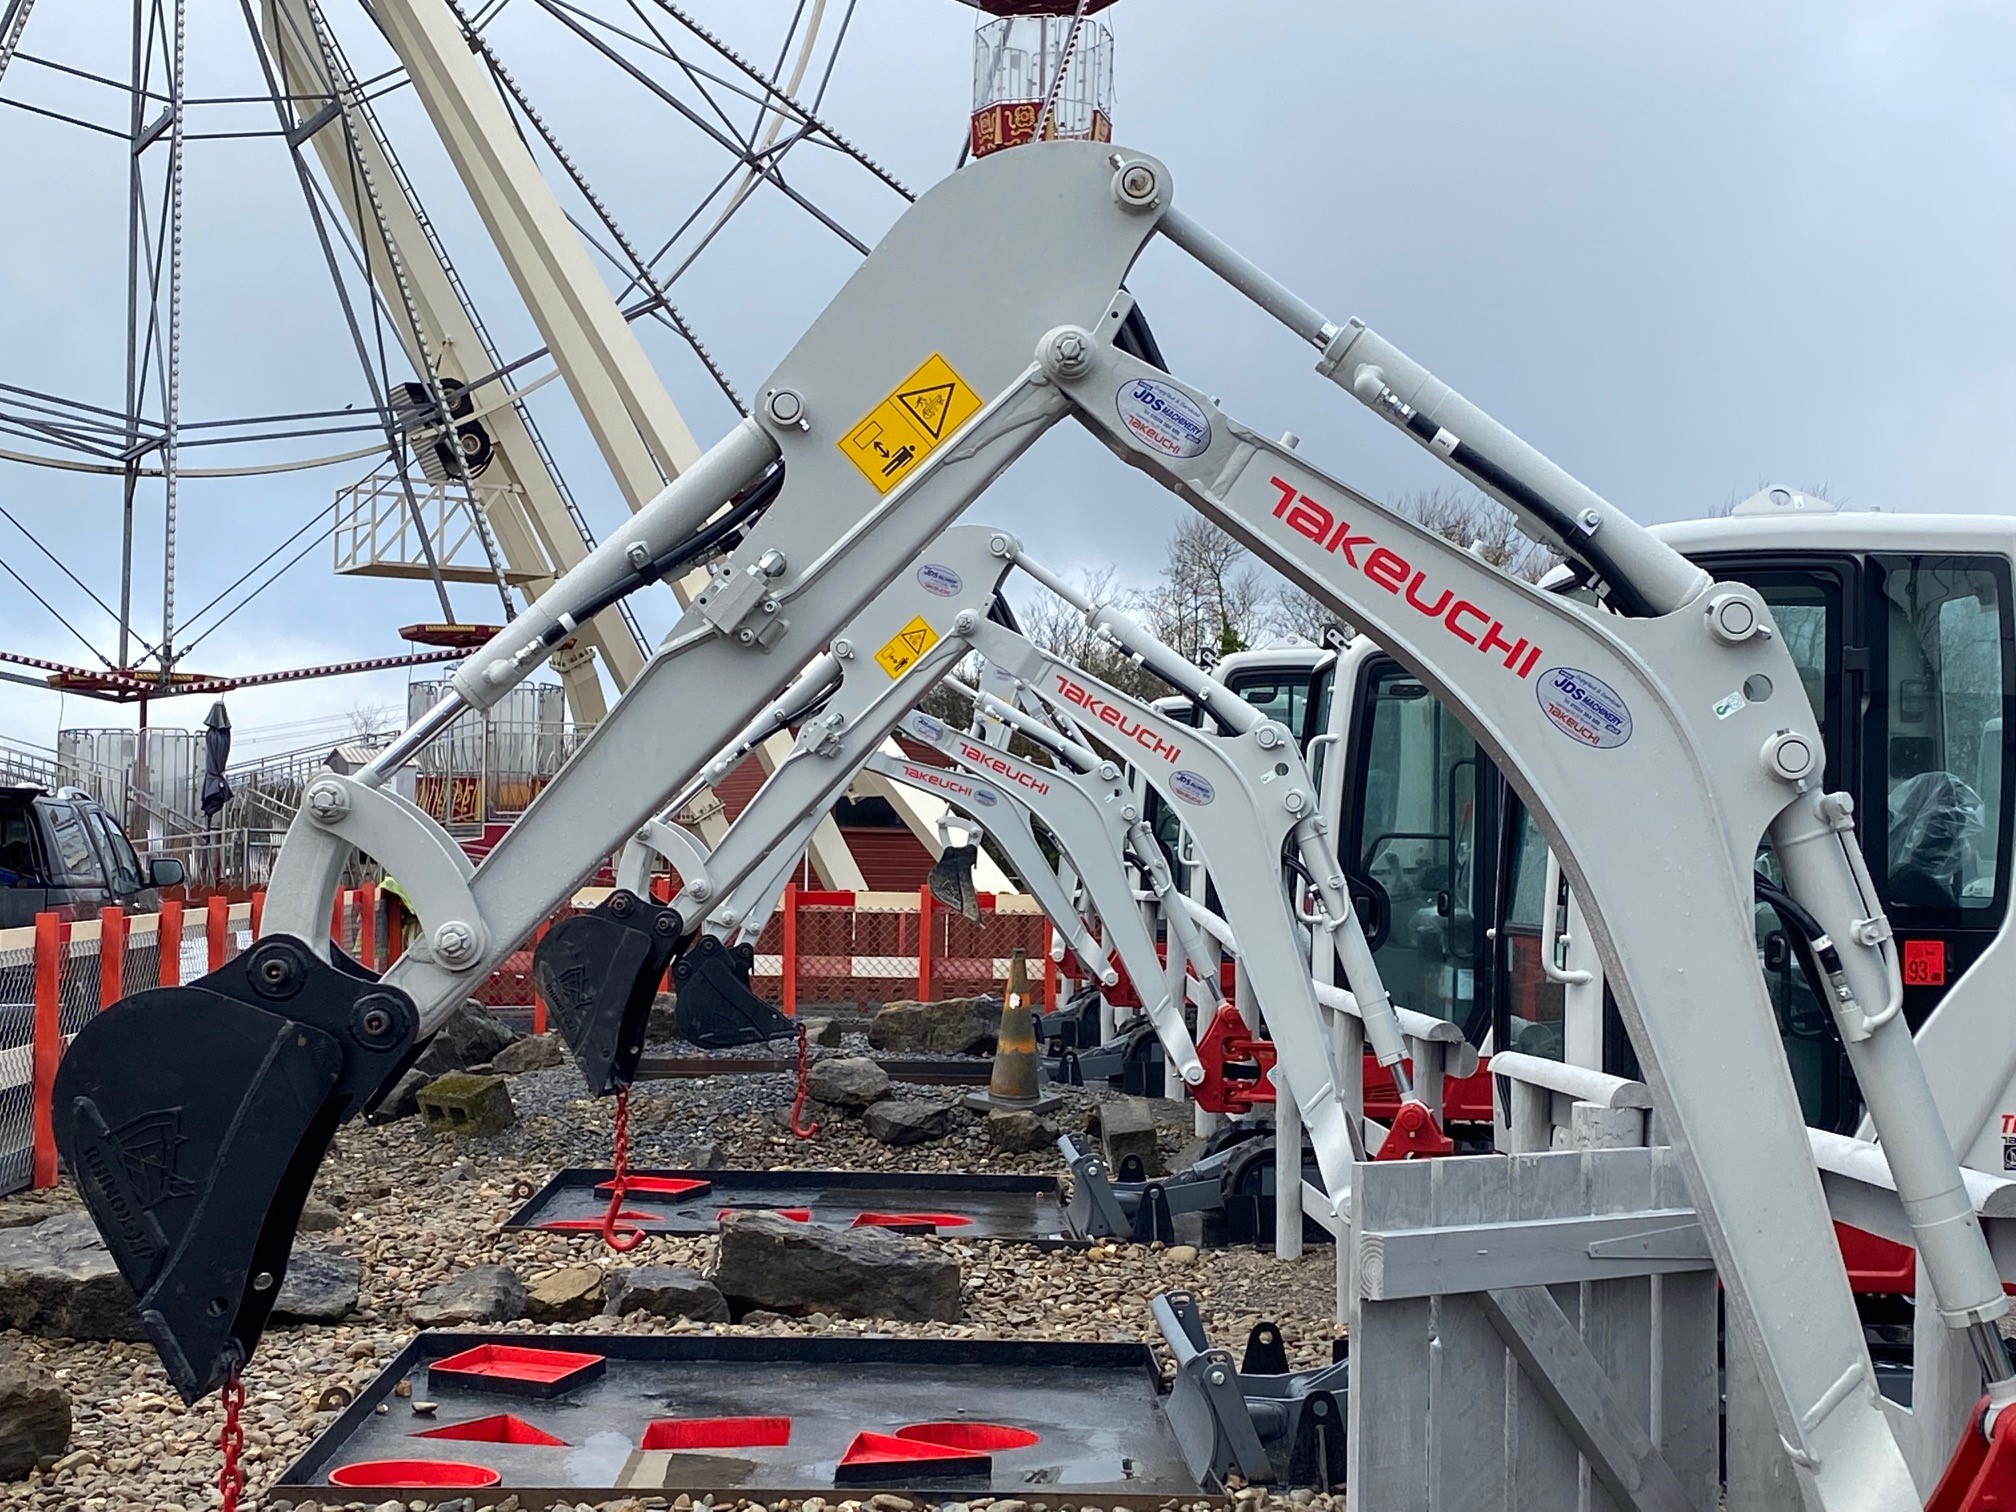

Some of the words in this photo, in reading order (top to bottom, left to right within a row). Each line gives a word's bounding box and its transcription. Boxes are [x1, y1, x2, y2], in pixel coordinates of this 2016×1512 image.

[1133, 389, 1165, 411] JDS
[1161, 406, 1202, 435] MACHINERY
[1554, 678, 1585, 700] JDS
[1582, 696, 1623, 726] MACHINERY
[1909, 959, 1928, 982] 93
